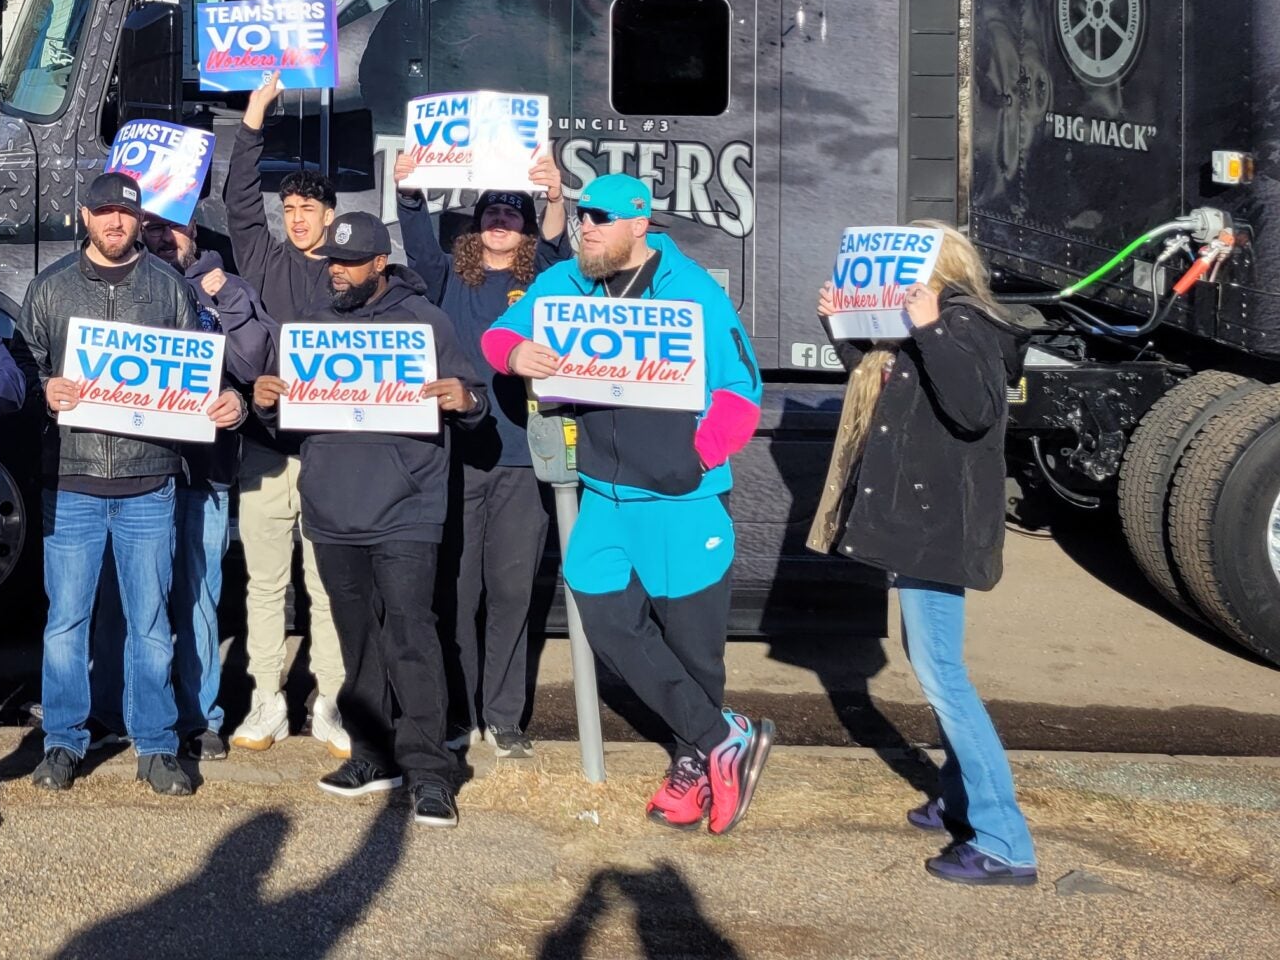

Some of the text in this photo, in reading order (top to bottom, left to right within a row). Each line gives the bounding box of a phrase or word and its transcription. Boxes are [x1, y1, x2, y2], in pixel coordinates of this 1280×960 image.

[205, 1, 325, 24] TEAMSTERS
[206, 21, 326, 52] VOTE
[206, 47, 276, 69] Workers
[416, 96, 540, 120] TEAMRS
[414, 118, 539, 149] VOE
[548, 118, 670, 132] UNCIL #3
[117, 123, 209, 158] TEAMSTES
[409, 141, 473, 164] Worke
[111, 141, 203, 184] VOT
[375, 135, 754, 238] TSTERS
[840, 232, 935, 254] EAMSTERS
[833, 255, 927, 289] VOTE
[832, 280, 908, 309] Workers Win
[543, 302, 693, 328] TEAMSTERS
[78, 325, 215, 359] TEAMSTERS
[289, 330, 426, 350] TEAMSTERS
[543, 326, 693, 363] VOTE
[76, 348, 212, 394] VOTE
[289, 352, 426, 384] VOTE
[636, 357, 696, 382] Win!
[76, 375, 212, 413] Workers Win!
[288, 377, 429, 404] Workers Win!
